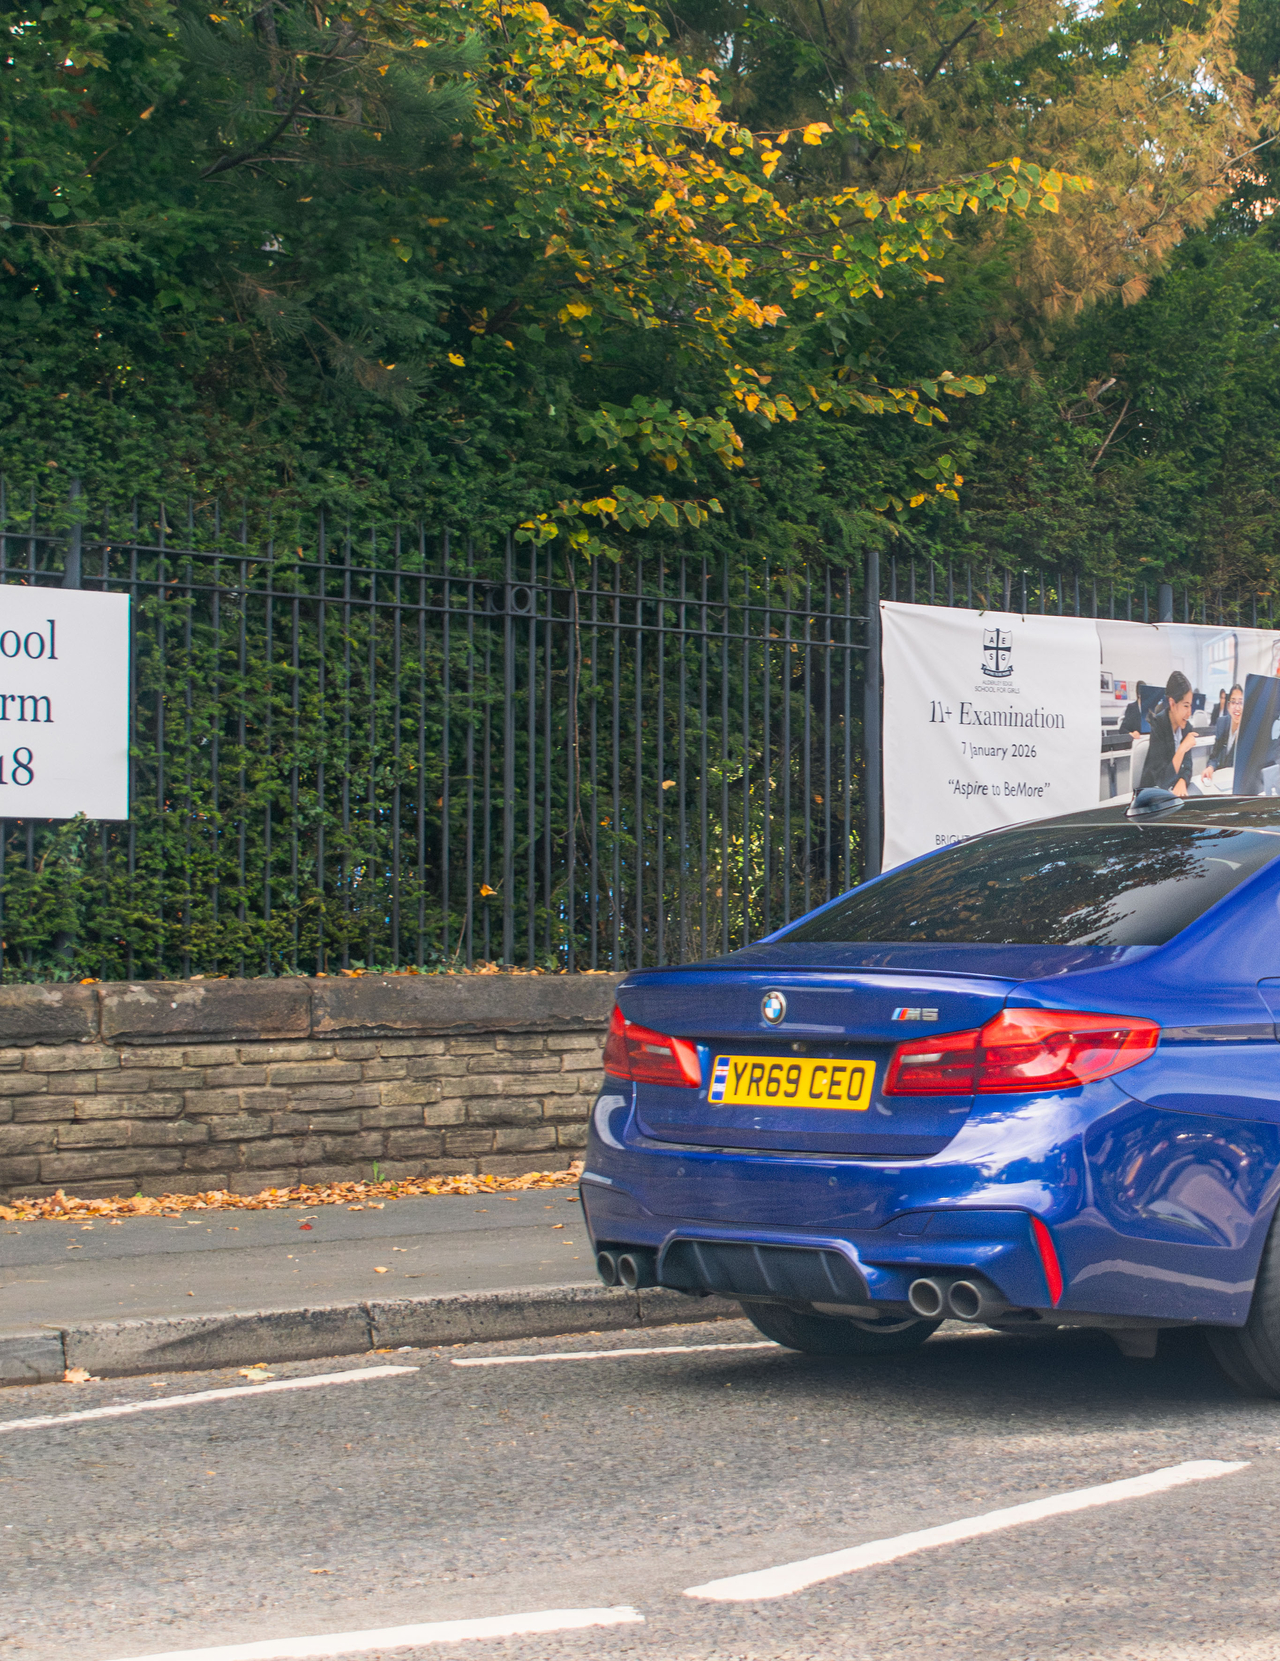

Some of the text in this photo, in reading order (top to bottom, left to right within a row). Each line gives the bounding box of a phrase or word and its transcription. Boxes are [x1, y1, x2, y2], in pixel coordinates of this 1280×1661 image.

[929, 700, 1066, 729] 11+ Examination
[961, 741, 1037, 761] 7 January 2026
[991, 784, 1001, 796] to
[935, 834, 970, 845] BRIG
[733, 1062, 802, 1098] YR69
